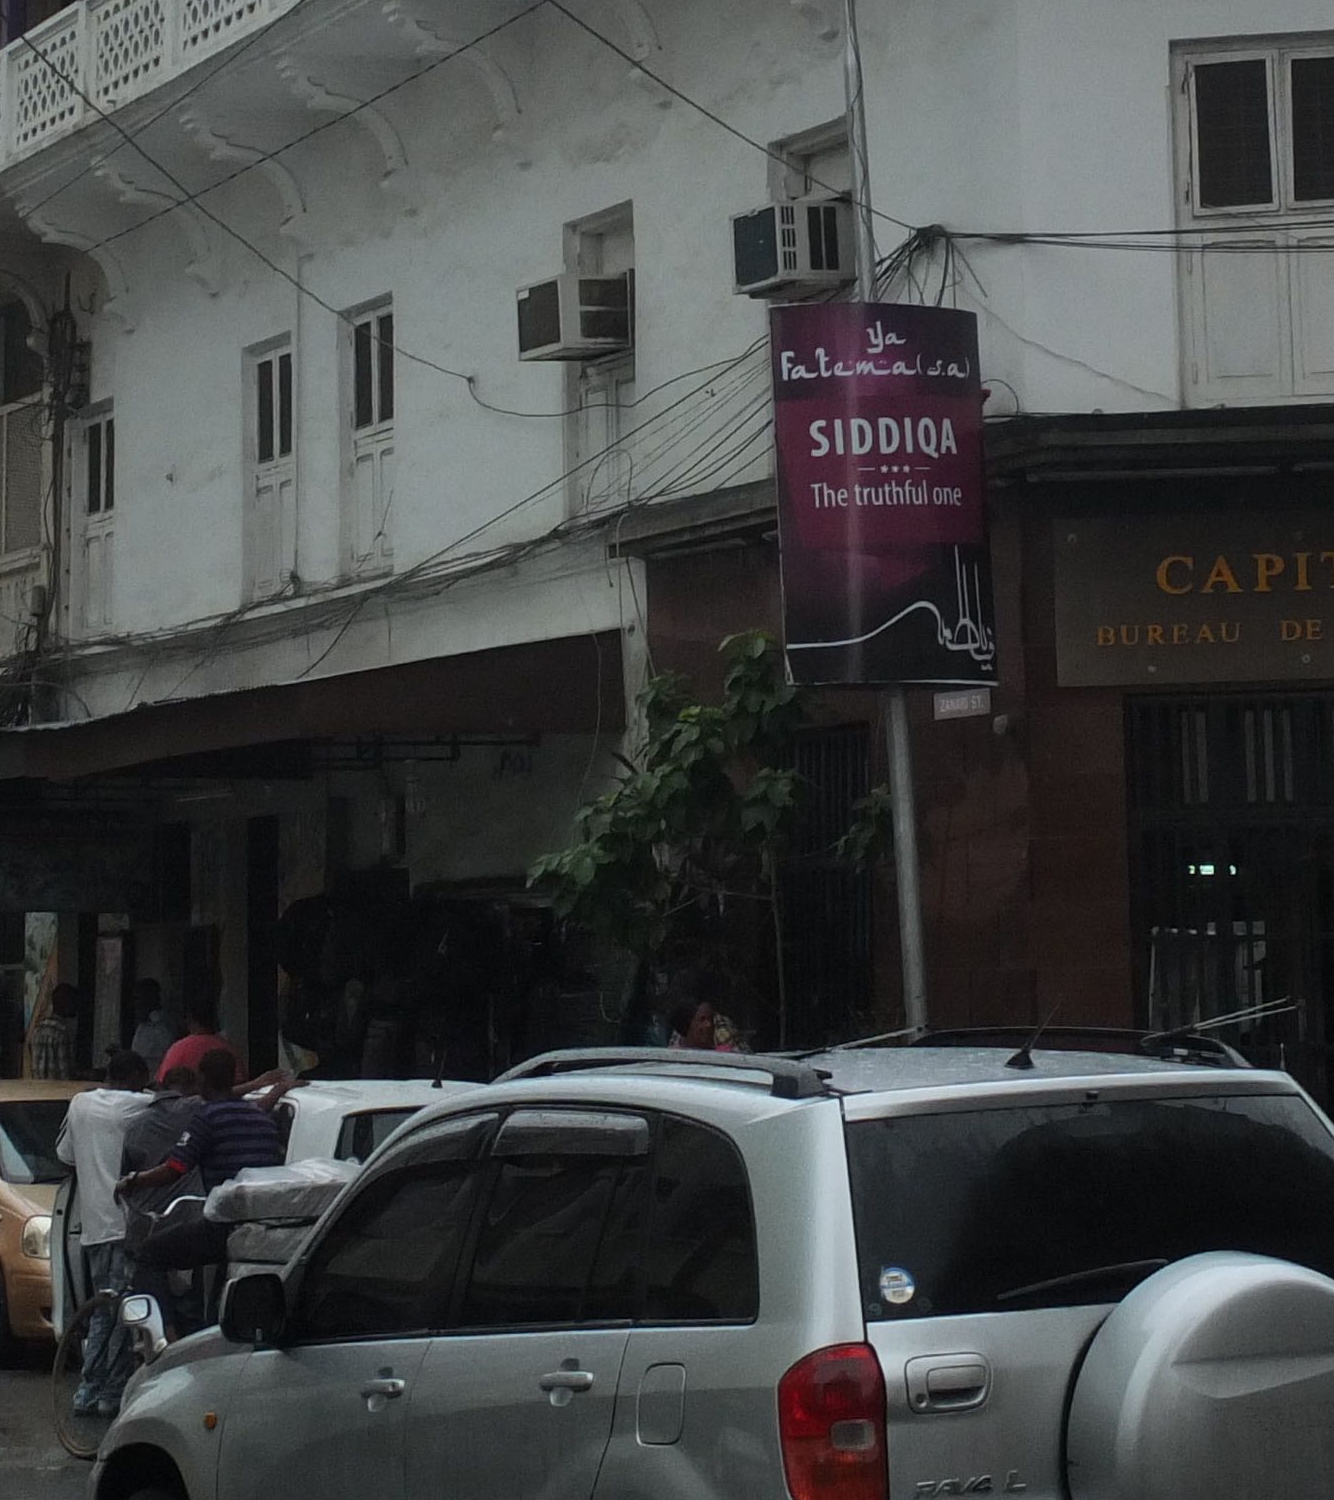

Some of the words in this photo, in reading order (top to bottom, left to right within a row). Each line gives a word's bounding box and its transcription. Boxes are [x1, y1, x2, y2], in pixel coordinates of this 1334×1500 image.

[867, 320, 907, 353] Ya
[809, 416, 958, 459] SIDDIQA
[811, 483, 848, 509] The
[854, 479, 929, 507] truthful
[932, 485, 962, 507] one
[1096, 622, 1243, 647] BUREAU
[1279, 618, 1324, 642] DE
